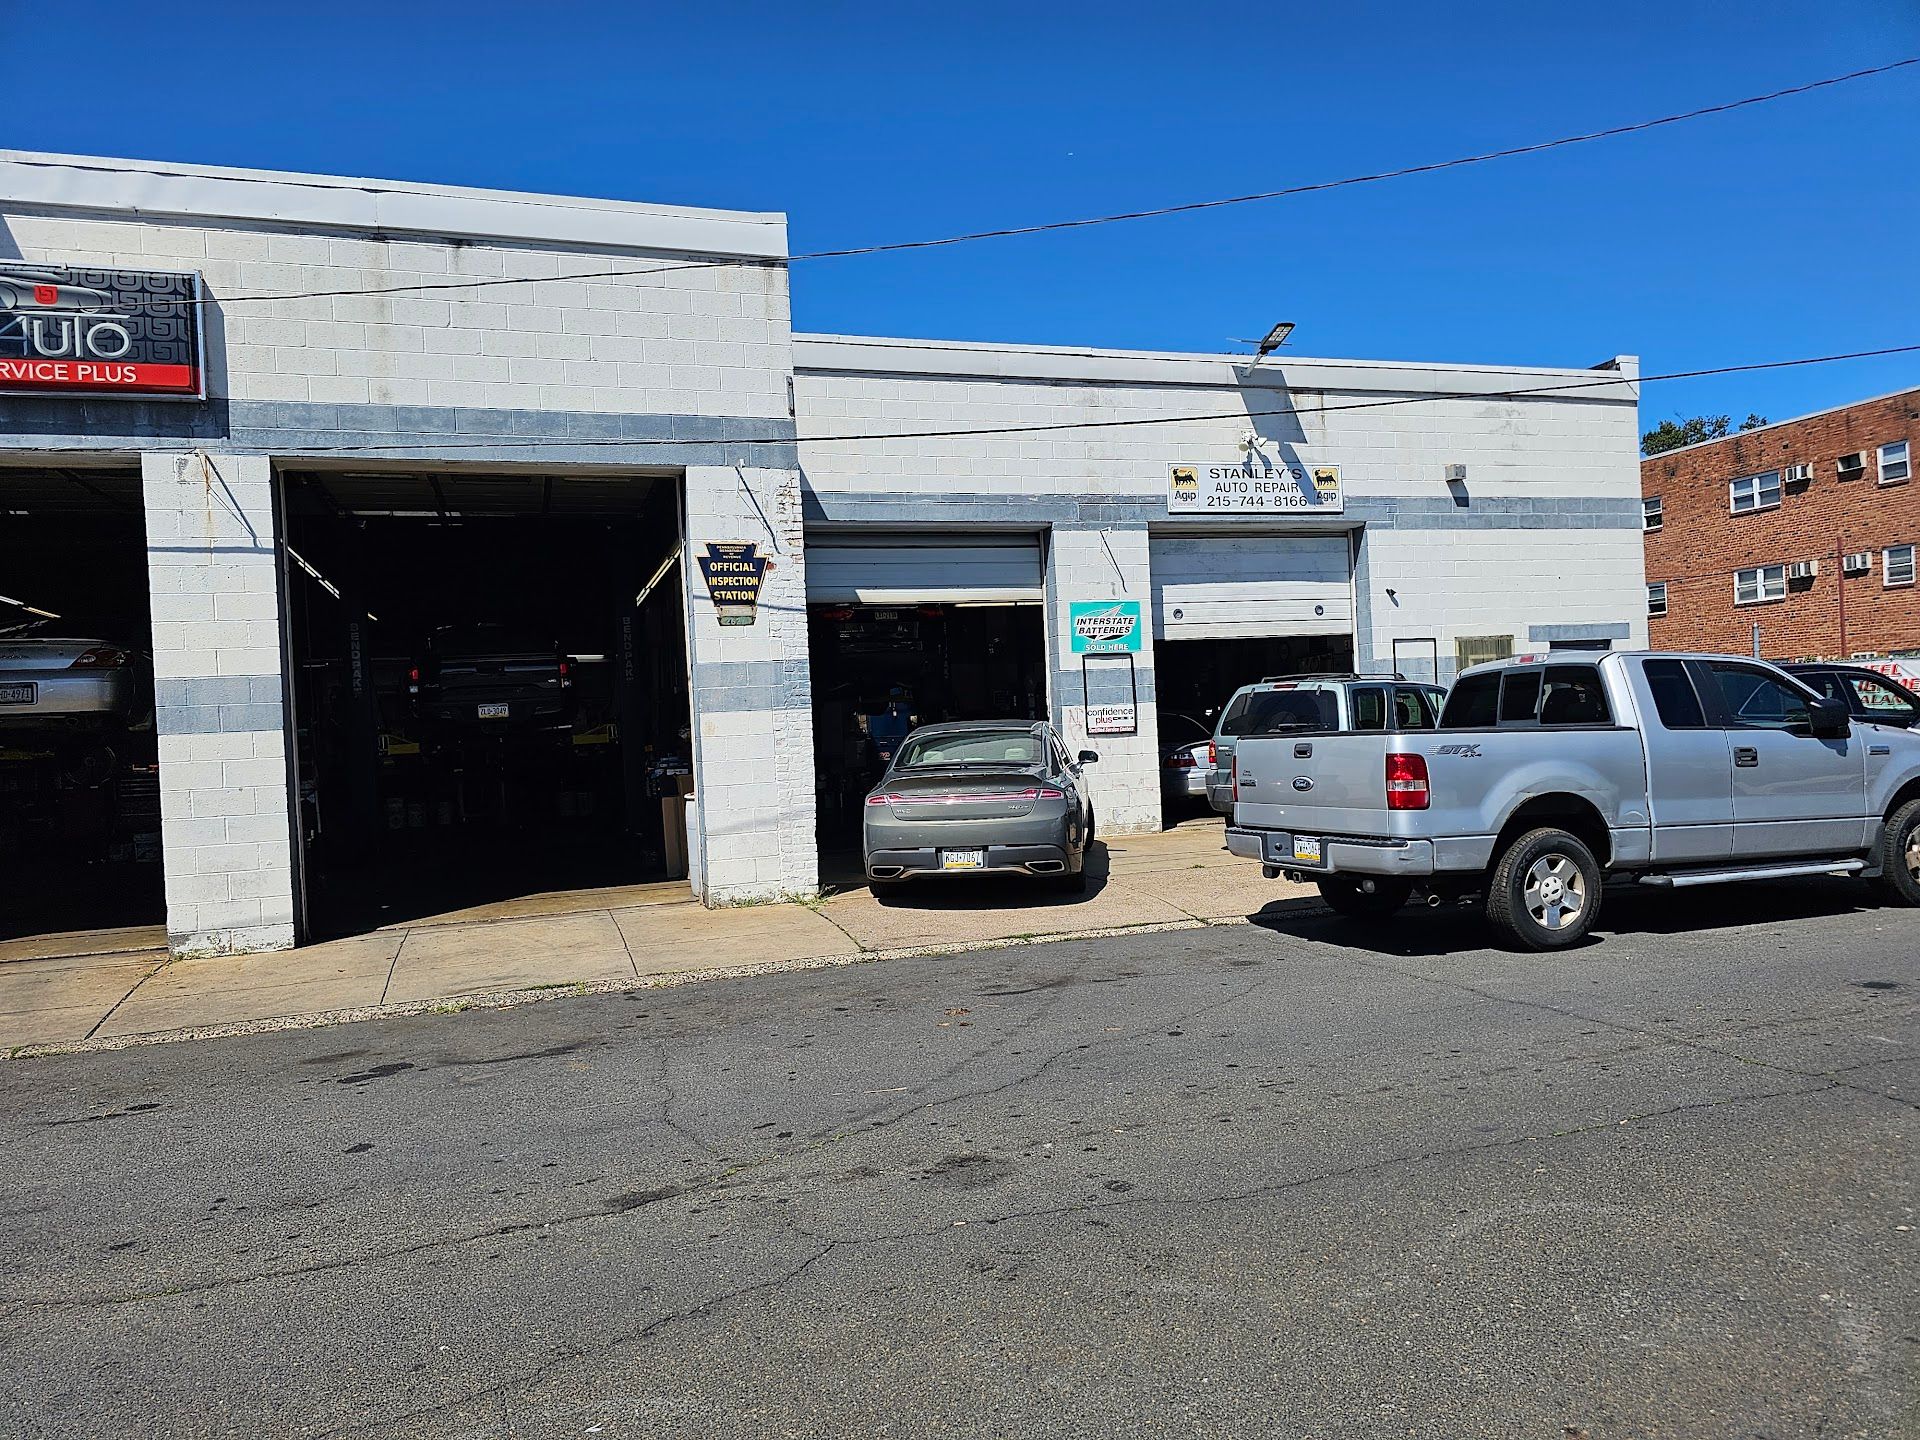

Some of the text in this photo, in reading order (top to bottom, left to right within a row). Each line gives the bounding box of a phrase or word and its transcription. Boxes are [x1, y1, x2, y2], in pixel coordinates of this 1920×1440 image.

[77, 364, 138, 383] PLUS
[1209, 468, 1303, 479] STANLEY'S
[1215, 482, 1299, 493] AUTO REPAIR
[1174, 490, 1197, 502] Agip
[1207, 495, 1308, 507] 215-744-8166
[1316, 491, 1337, 502] Agip
[709, 562, 757, 572] OFFICIAL
[708, 576, 759, 586] INSPECTION
[713, 590, 755, 600] STATION
[1076, 617, 1135, 626] INTERSTATE
[1078, 626, 1131, 635] BATTERIES
[1108, 643, 1129, 651] HERE
[1087, 707, 1134, 717] confidence
[1095, 716, 1113, 726] plus
